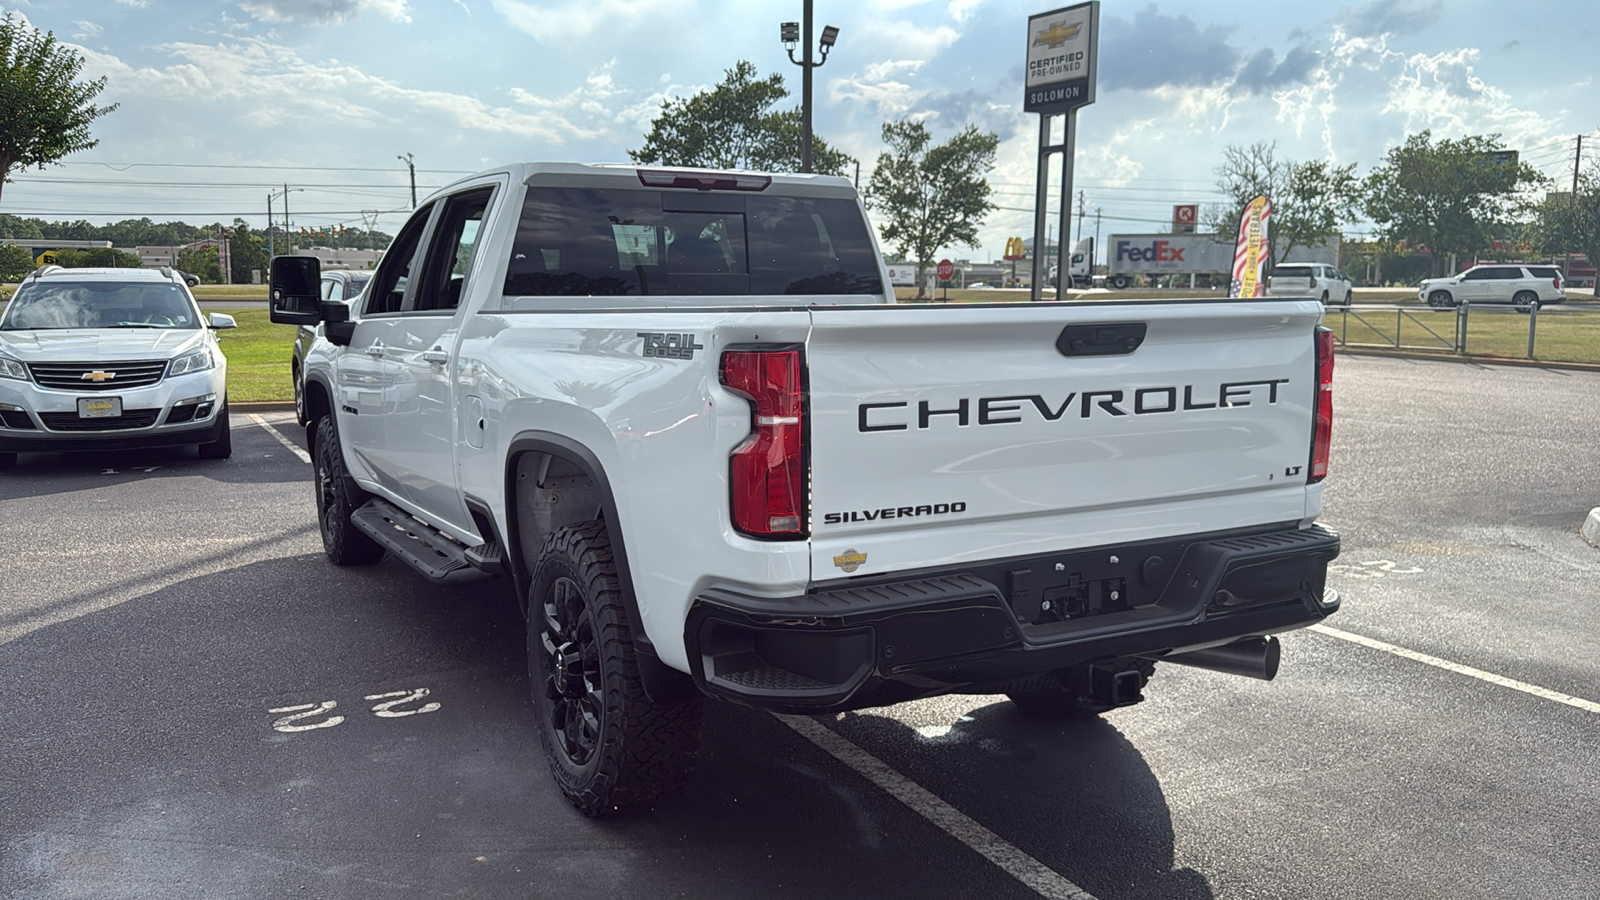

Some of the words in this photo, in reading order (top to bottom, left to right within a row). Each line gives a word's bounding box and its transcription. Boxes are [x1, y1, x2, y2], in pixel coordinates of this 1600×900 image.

[1030, 52, 1083, 70] CERTIFIED
[1031, 62, 1081, 78] PRE-OWNED
[1030, 87, 1079, 104] SOLOMON
[1249, 205, 1263, 249] VETERANS
[1117, 241, 1185, 262] FedEx
[938, 265, 953, 275] STOP
[637, 333, 703, 350] TRAIL
[642, 346, 694, 360] BOSS
[858, 379, 1290, 433] CHEVROLET
[1285, 465, 1302, 477] LT
[824, 501, 967, 524] SILVERADO
